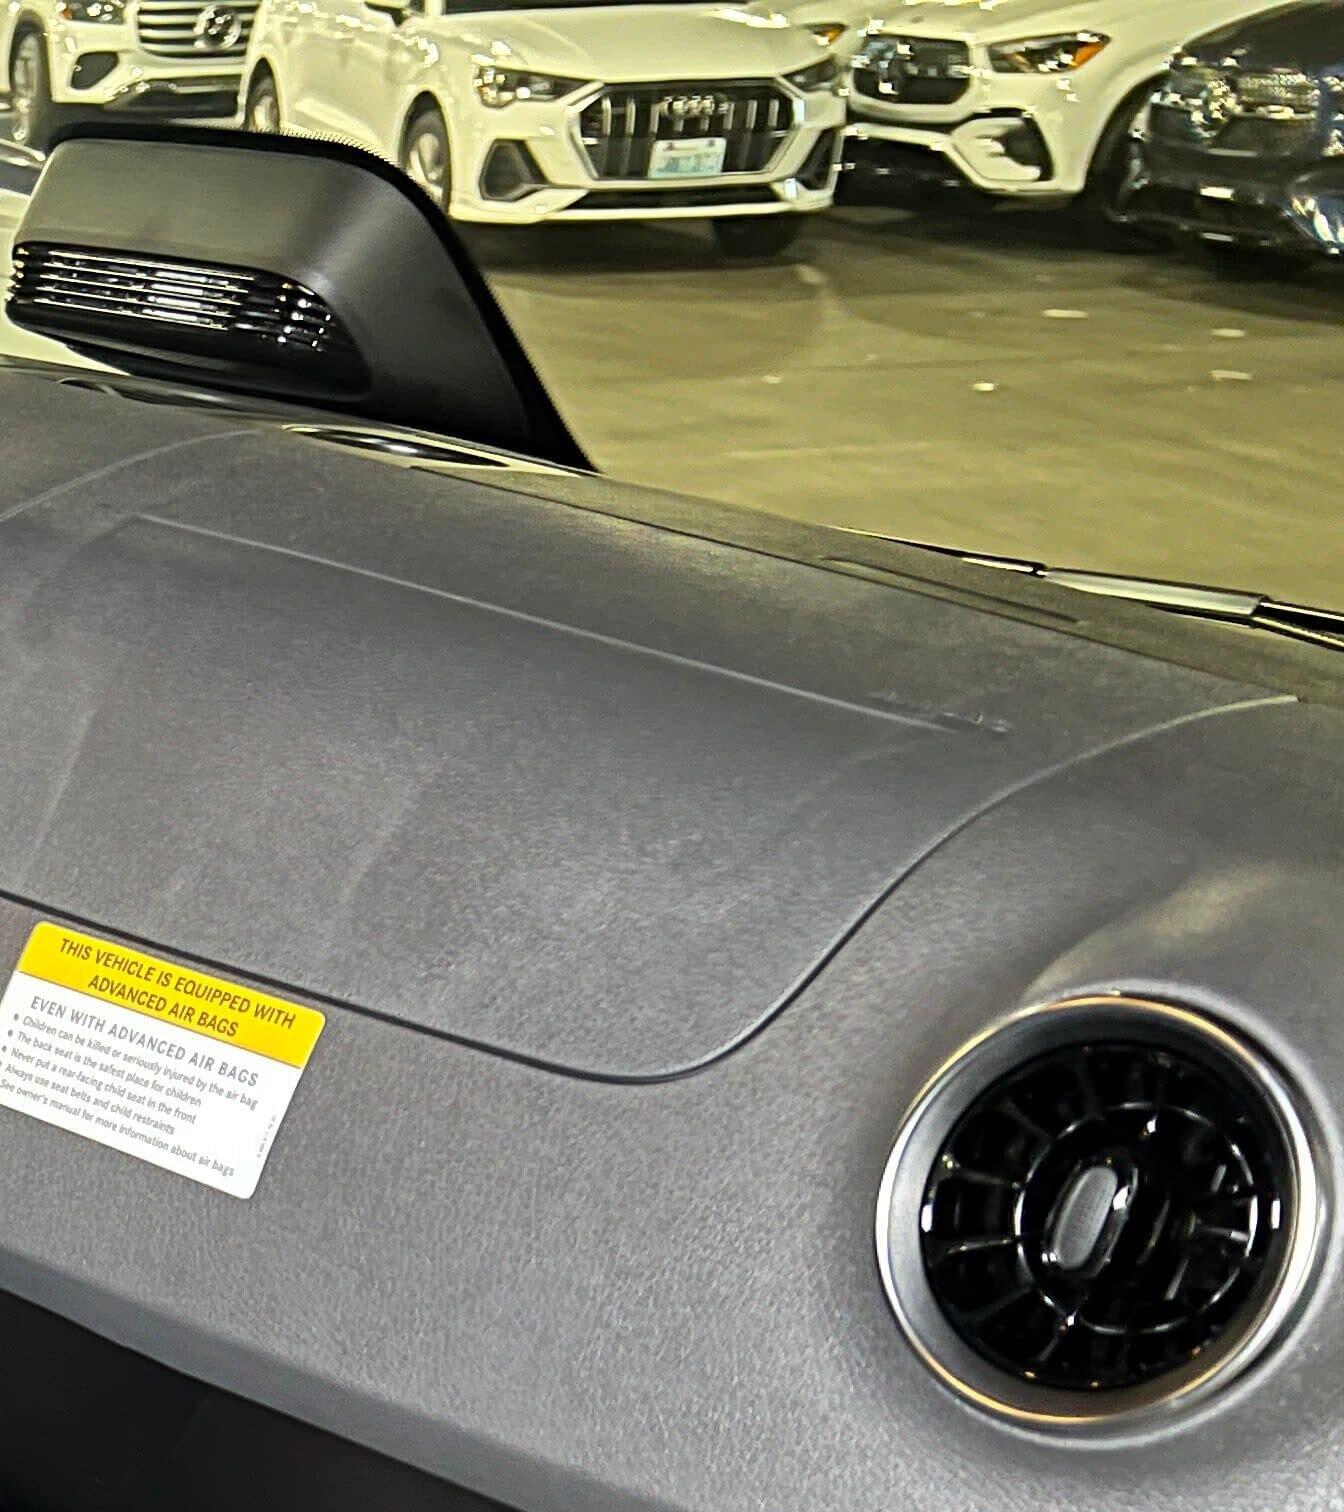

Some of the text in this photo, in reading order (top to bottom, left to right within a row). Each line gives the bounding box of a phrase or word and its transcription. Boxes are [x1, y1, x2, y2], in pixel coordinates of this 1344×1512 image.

[60, 938, 297, 1029] THIS VEHICLE IS EQUIPPED WITH
[87, 974, 239, 1037] ADVANCED AIR BAGS
[17, 1030, 33, 1046] The
[32, 1036, 53, 1052] back
[53, 1046, 74, 1060] seat
[82, 1055, 98, 1069] the
[98, 1062, 126, 1080] safest
[124, 1072, 150, 1088] place
[150, 1079, 165, 1093] for
[164, 1087, 202, 1108] children
[22, 1015, 58, 1037] Children
[57, 1029, 74, 1042] can
[86, 1038, 112, 1056] killed
[122, 1053, 163, 1076] seriously
[162, 1065, 196, 1086] injured
[208, 1082, 225, 1097] the
[224, 1089, 240, 1100] air
[239, 1092, 259, 1112] bag
[30, 995, 259, 1087] EVEN WITH ADVANCED AIR BAGS
[0, 1078, 235, 1177] See owner's manual for more information about air bags
[4, 1063, 176, 1136] Always use seat belts and child restraints
[10, 1047, 38, 1064] Never
[34, 1058, 51, 1070] put
[58, 1066, 104, 1092] rear-facing
[103, 1082, 127, 1098] child
[126, 1091, 147, 1106] seat
[157, 1101, 173, 1116] the
[173, 1107, 197, 1125] front
